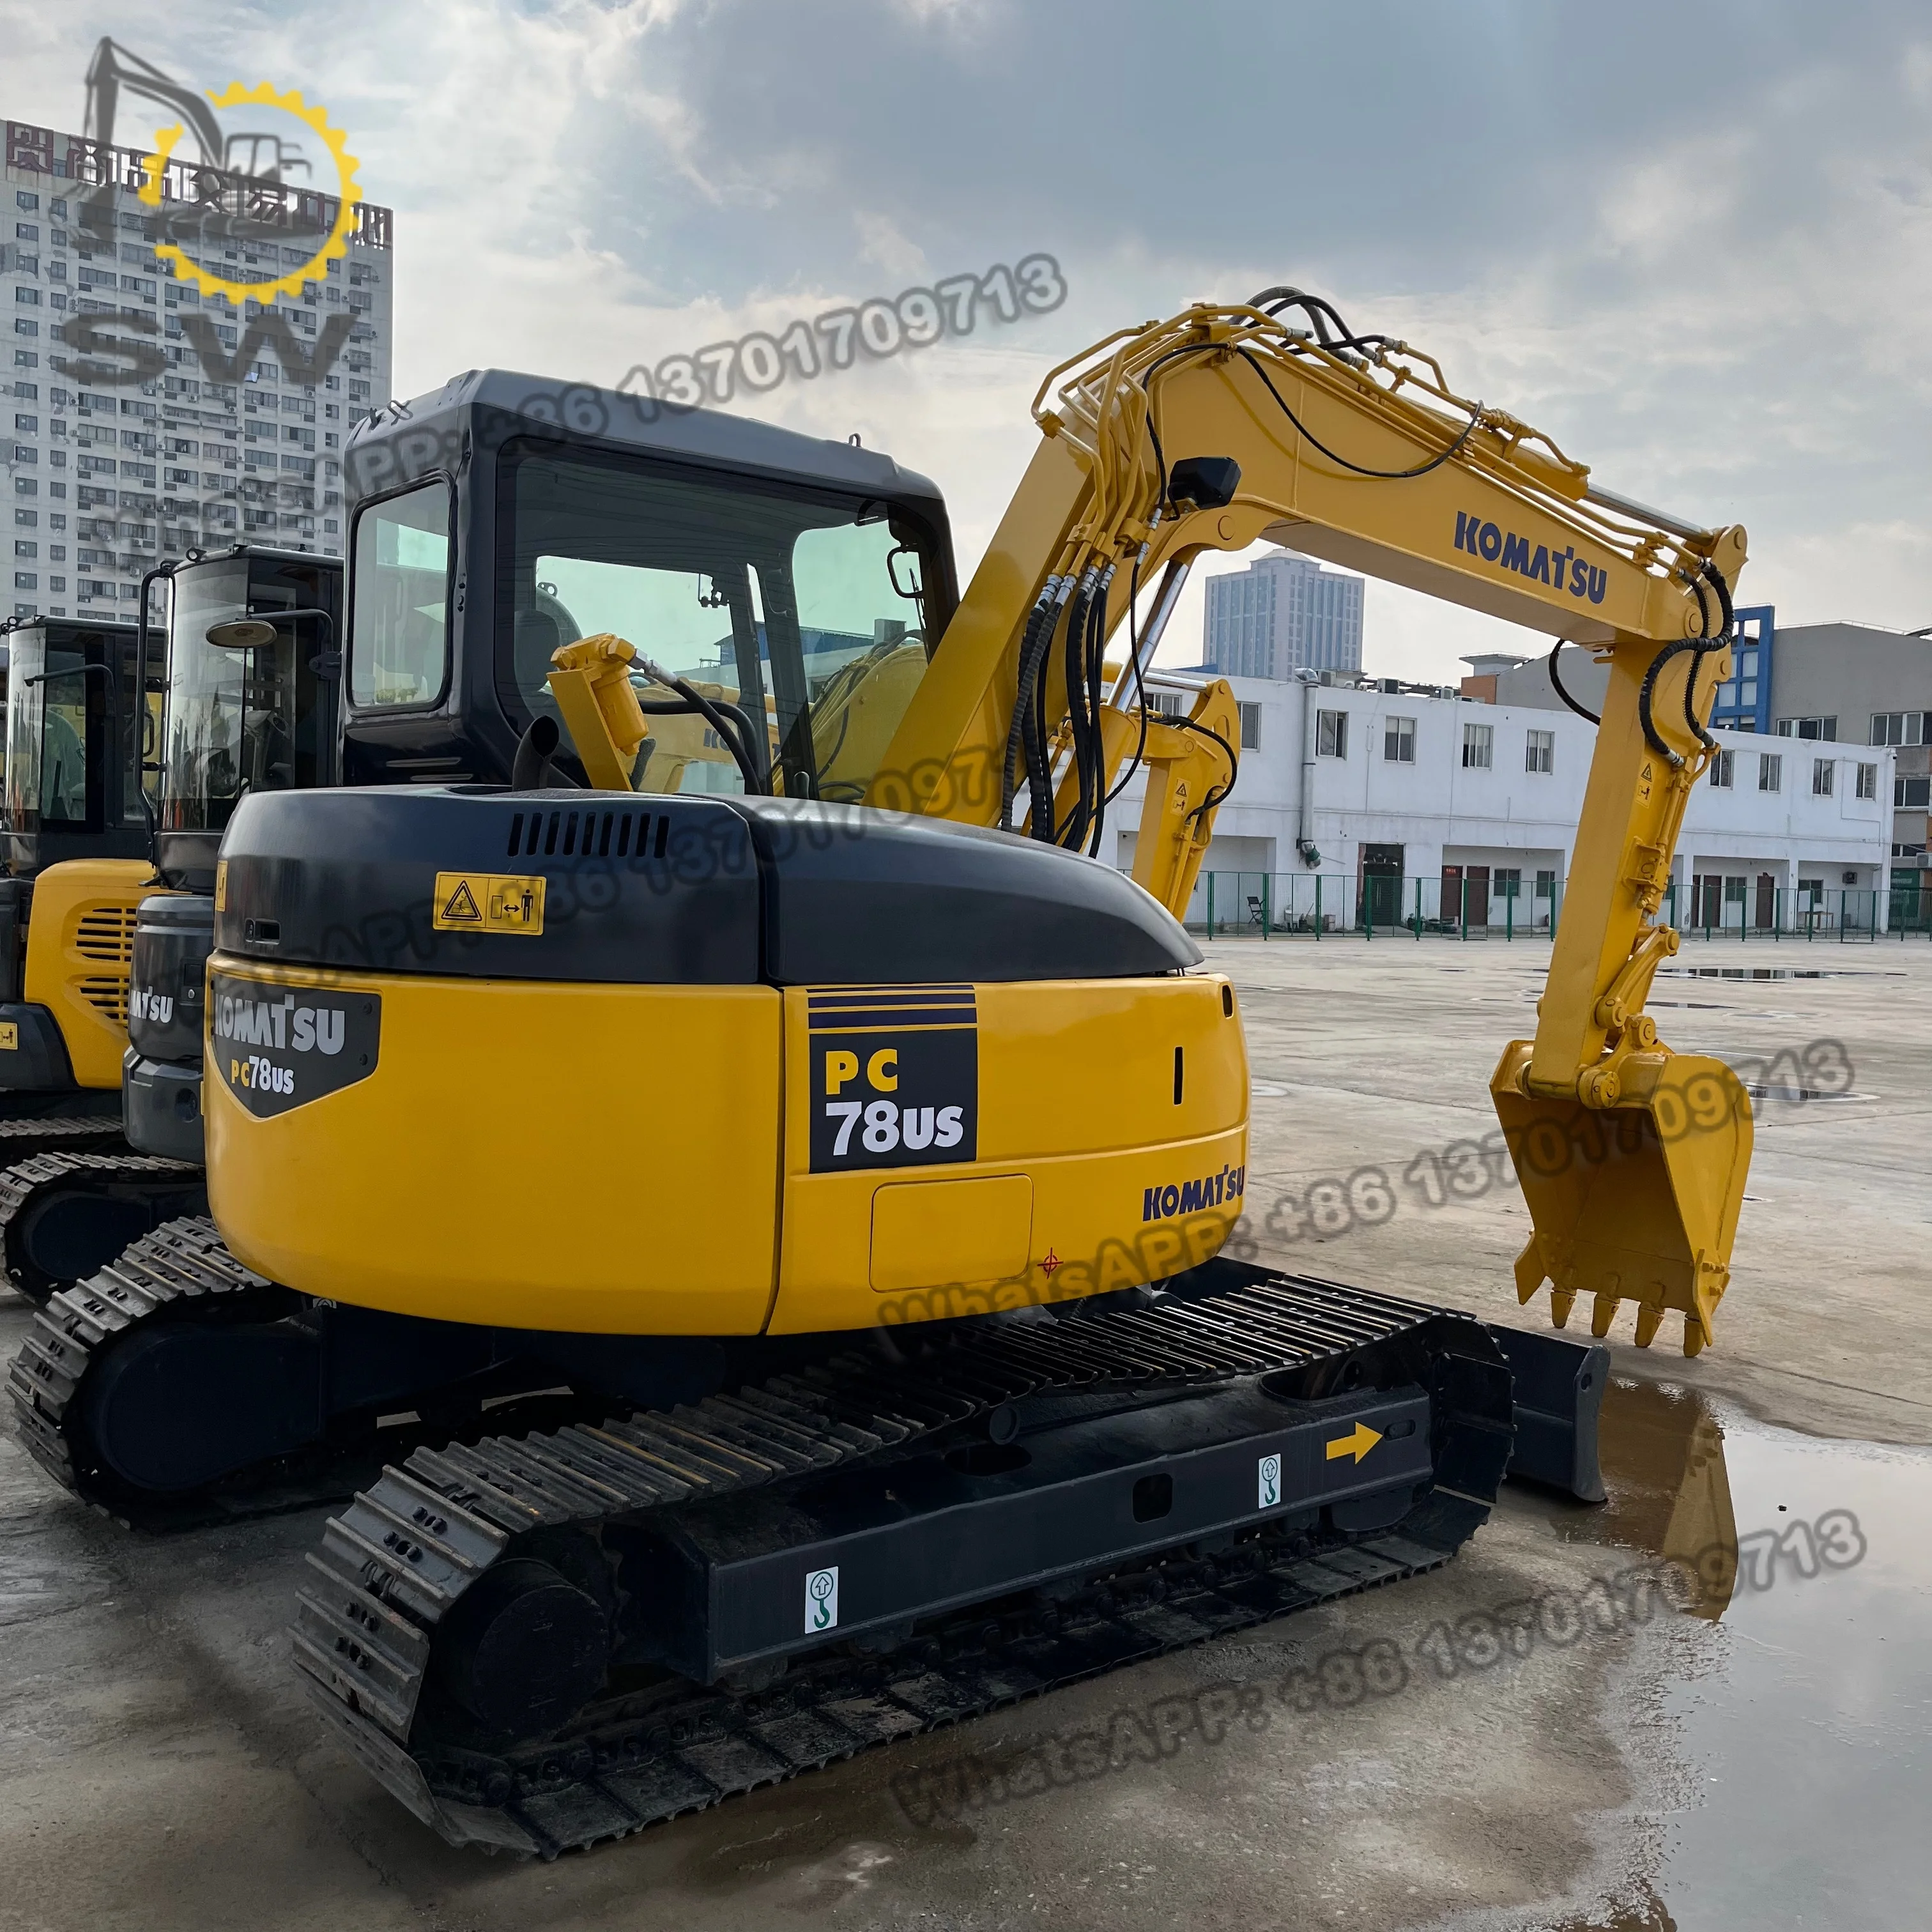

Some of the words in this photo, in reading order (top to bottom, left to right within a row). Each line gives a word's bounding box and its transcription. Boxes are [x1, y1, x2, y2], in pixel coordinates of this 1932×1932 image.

[1454, 510, 1607, 604] KOMATSU
[215, 993, 346, 1055] KOMATSU
[1142, 1164, 1245, 1222] KOMATSU
